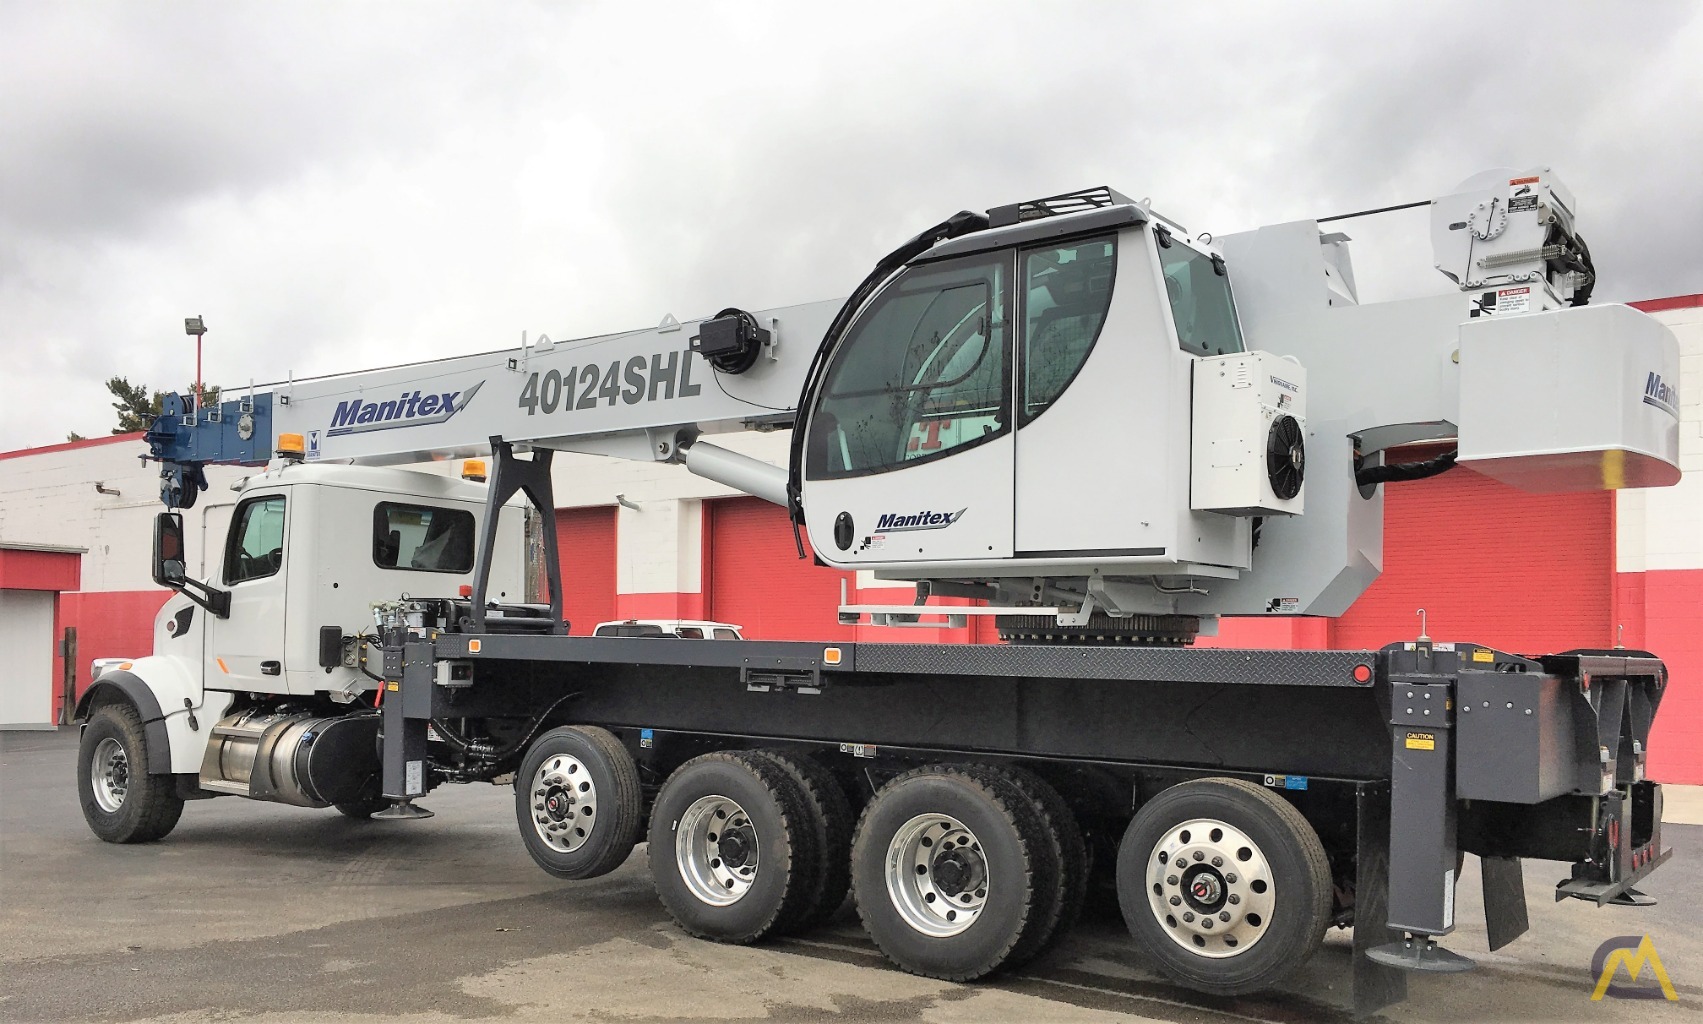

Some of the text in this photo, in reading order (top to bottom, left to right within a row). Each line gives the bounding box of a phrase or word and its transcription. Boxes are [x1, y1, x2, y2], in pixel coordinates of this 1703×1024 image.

[518, 349, 702, 417] 40124SHL
[330, 389, 461, 428] Manitex
[877, 510, 954, 529] Manitex
[1406, 732, 1434, 740] CAUTION
